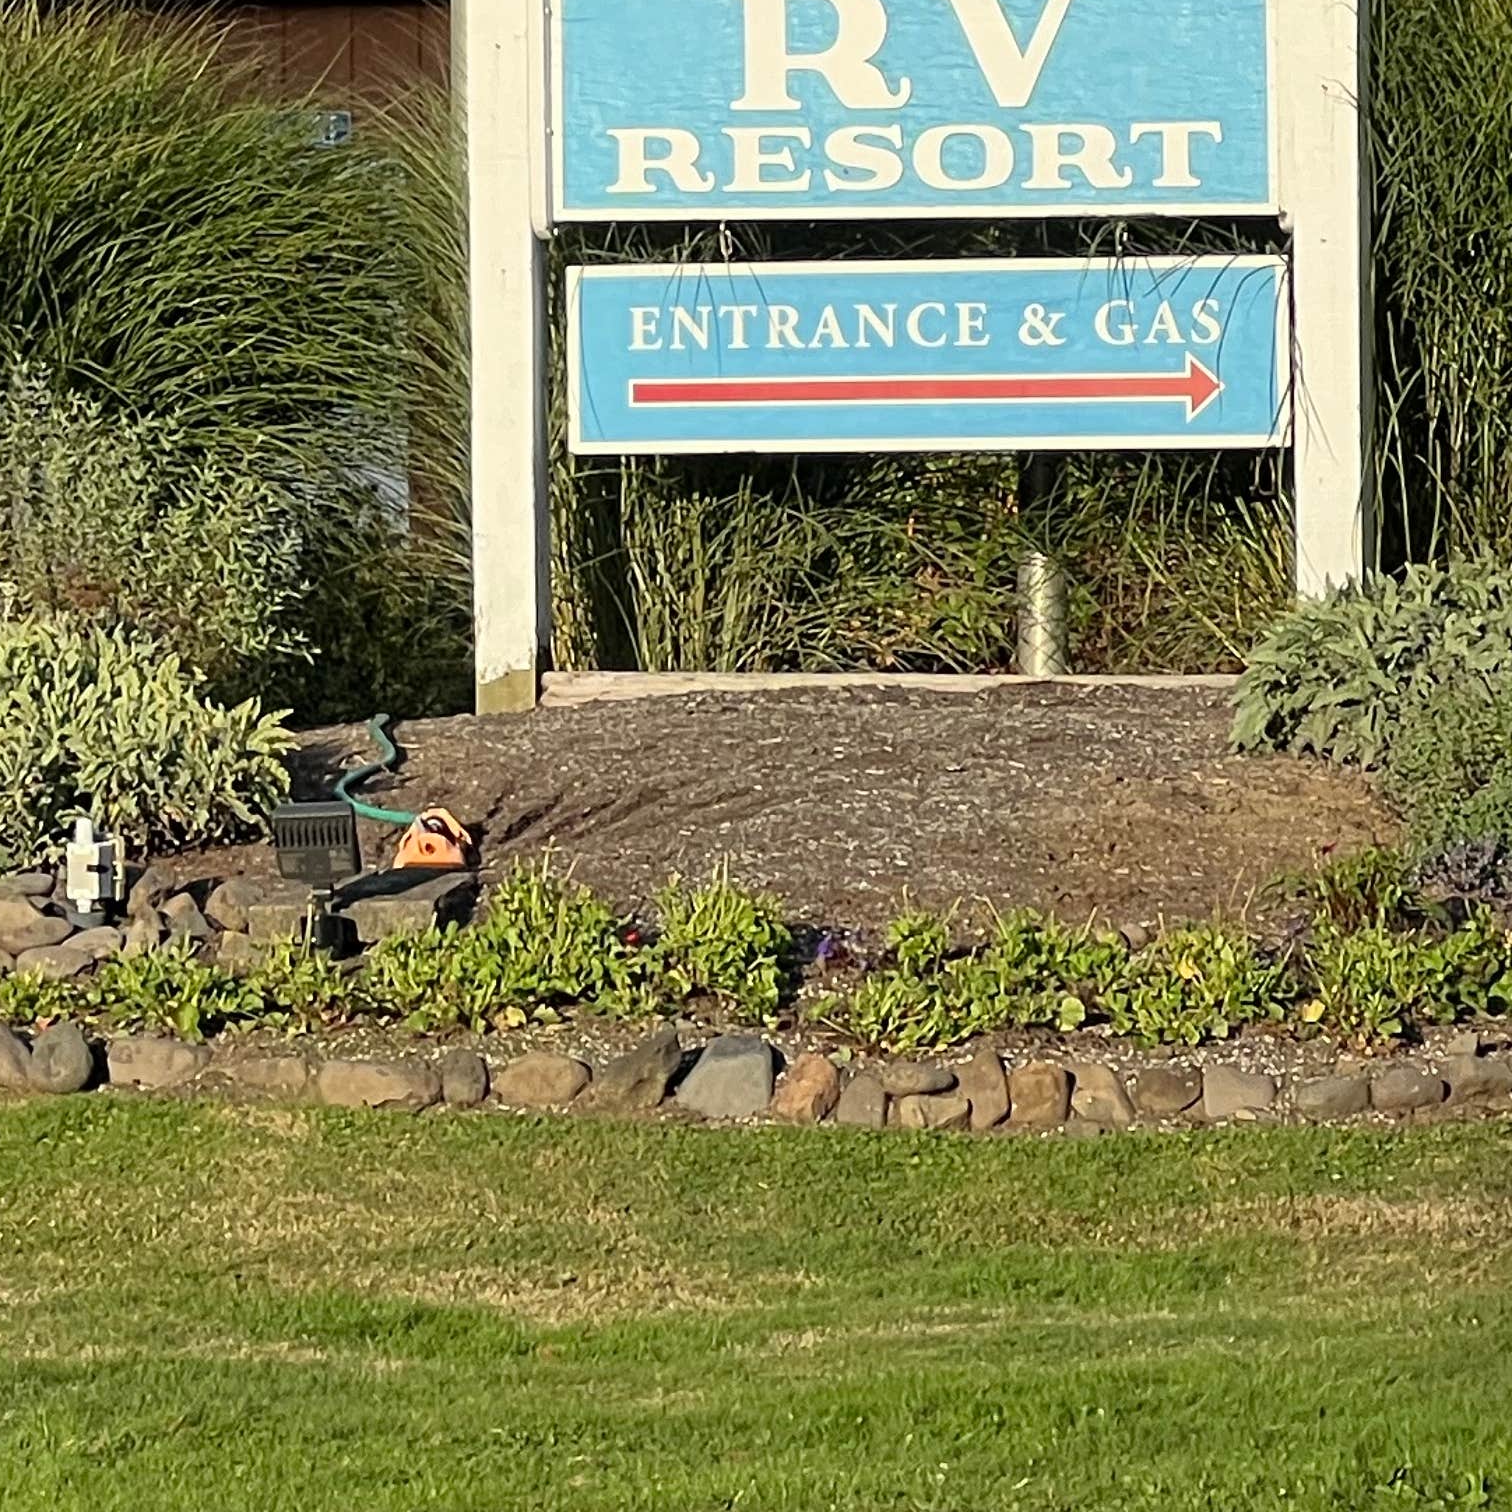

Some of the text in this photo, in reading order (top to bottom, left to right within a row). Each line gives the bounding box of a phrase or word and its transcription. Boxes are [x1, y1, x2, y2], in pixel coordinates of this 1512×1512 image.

[605, 120, 1224, 193] RESORT
[627, 298, 1224, 352] ENTRANCE & GAS
